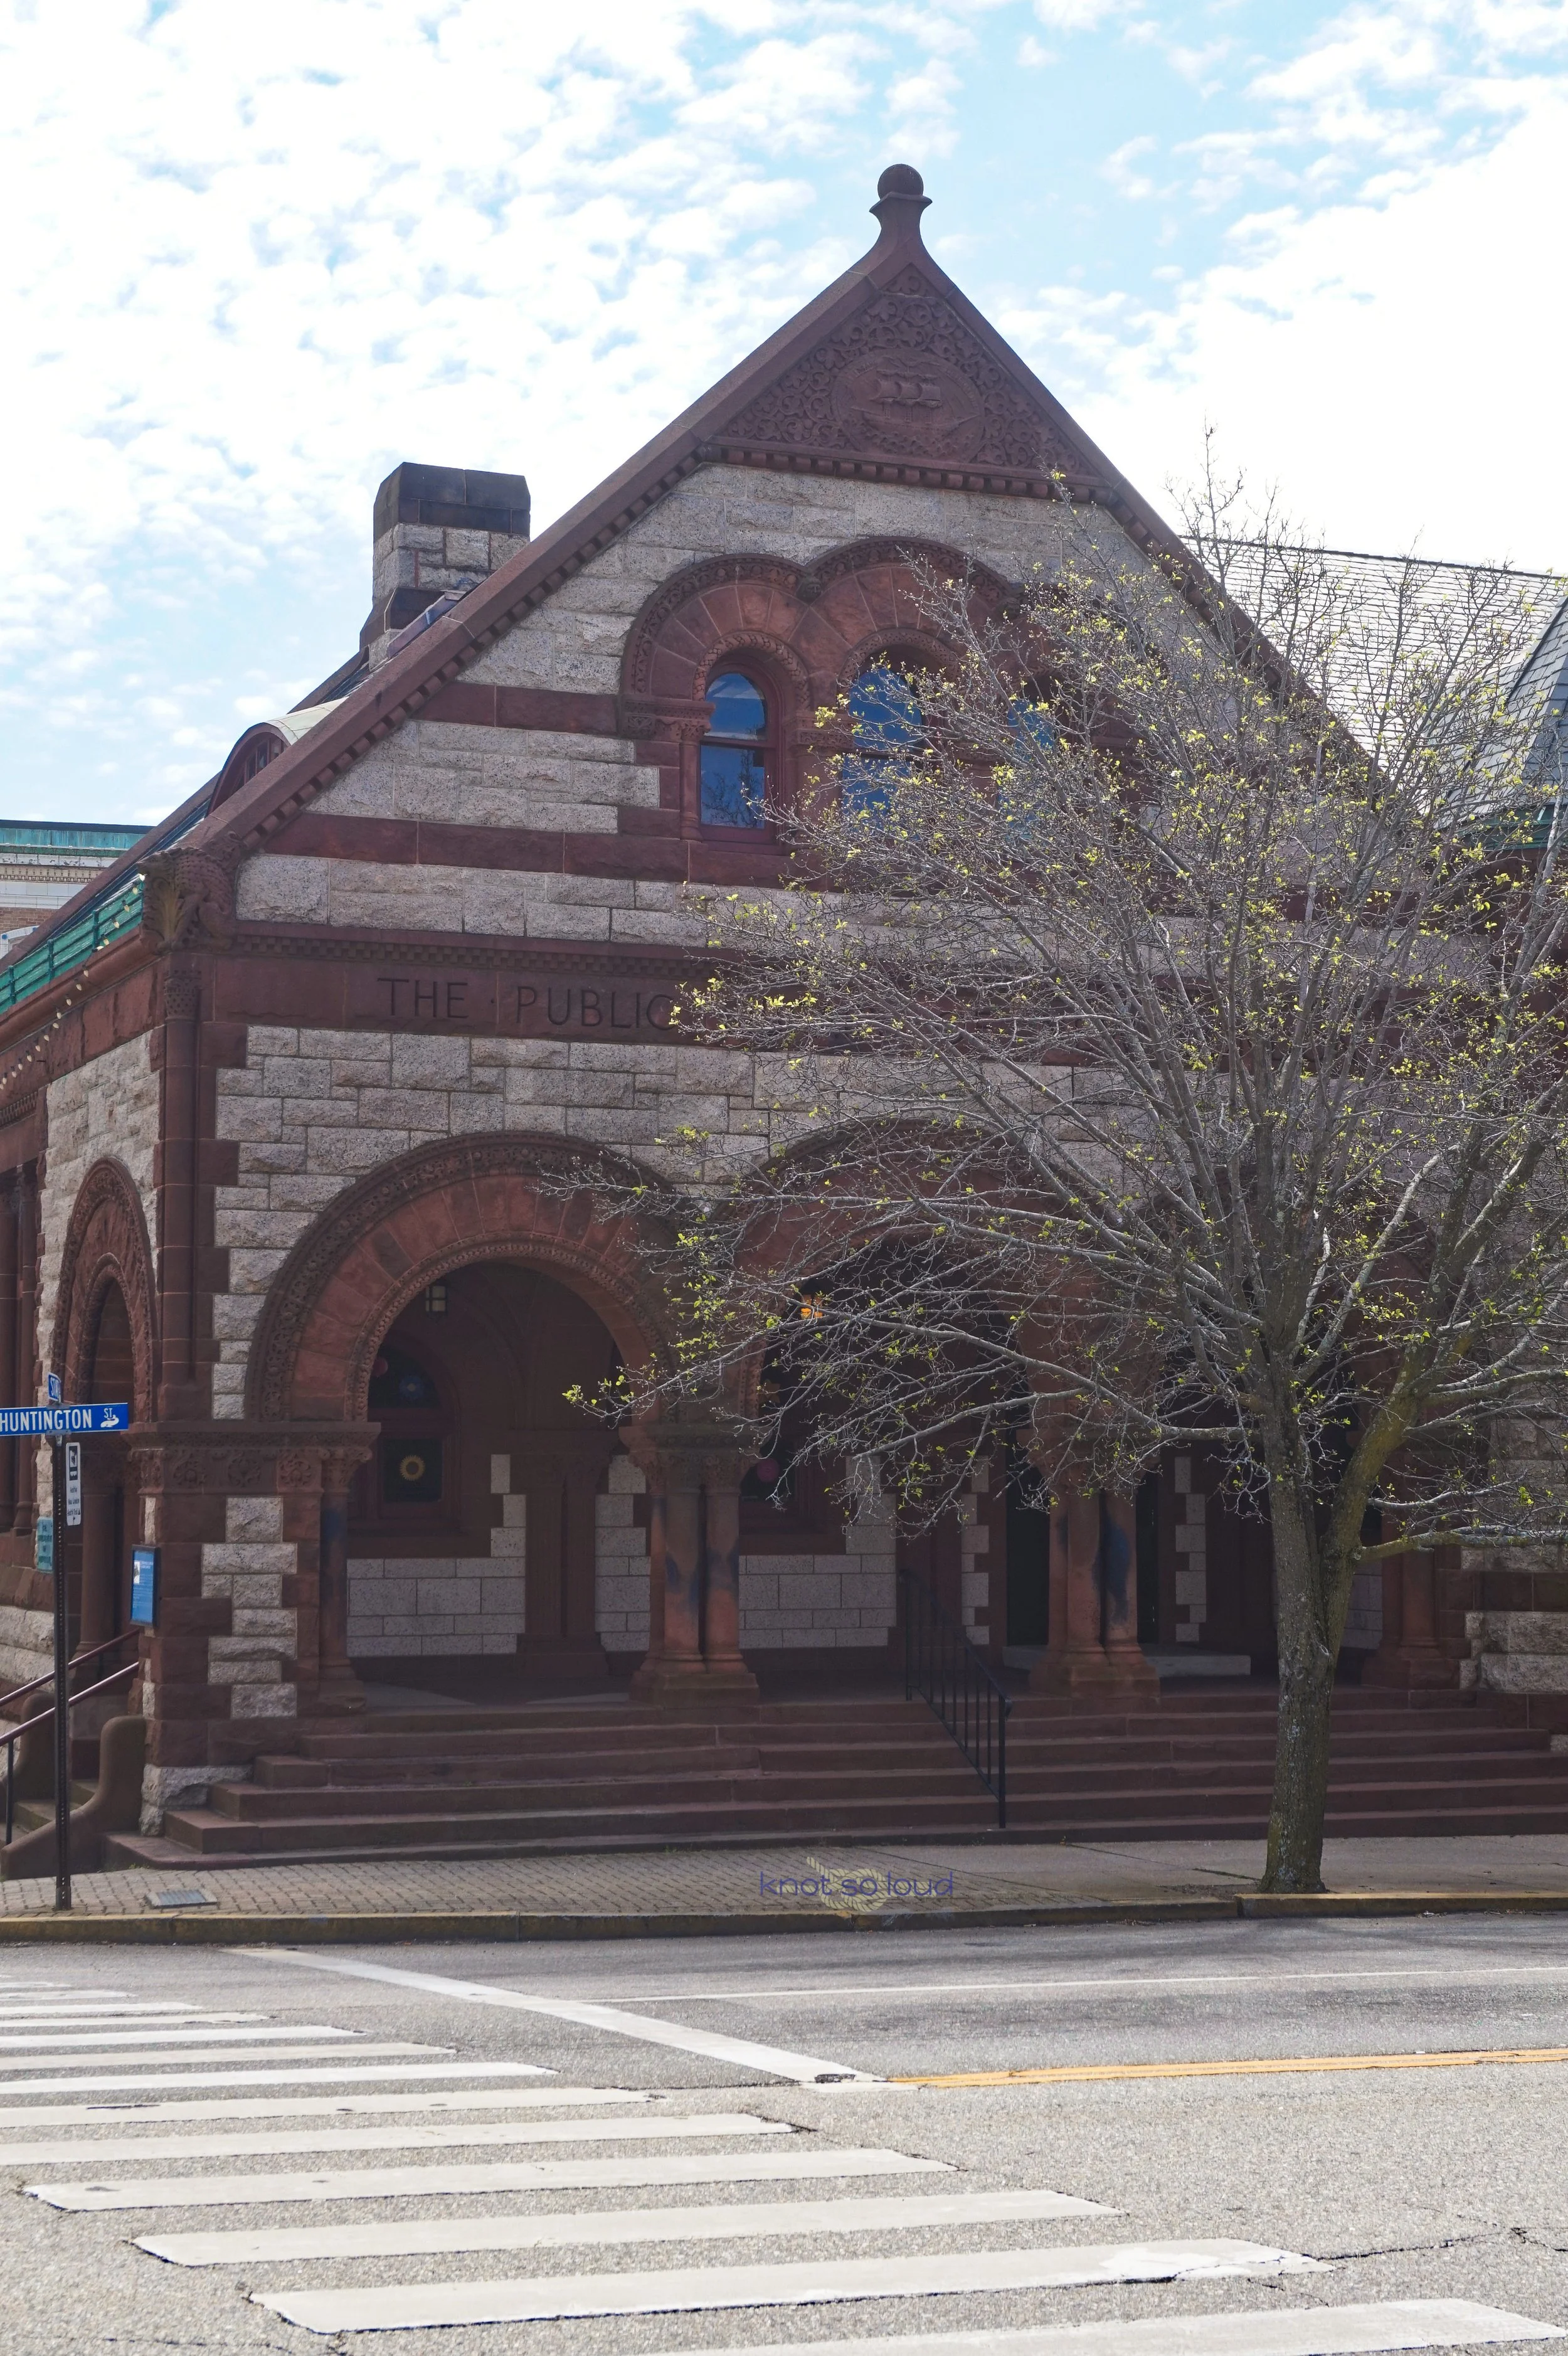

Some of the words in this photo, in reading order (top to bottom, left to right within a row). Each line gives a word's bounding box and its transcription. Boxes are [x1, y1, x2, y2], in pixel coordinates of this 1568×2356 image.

[376, 977, 469, 1019] THE
[516, 985, 676, 1031] PUBLIC
[0, 1409, 92, 1432] HUNTINGTON
[103, 1408, 113, 1419] ST
